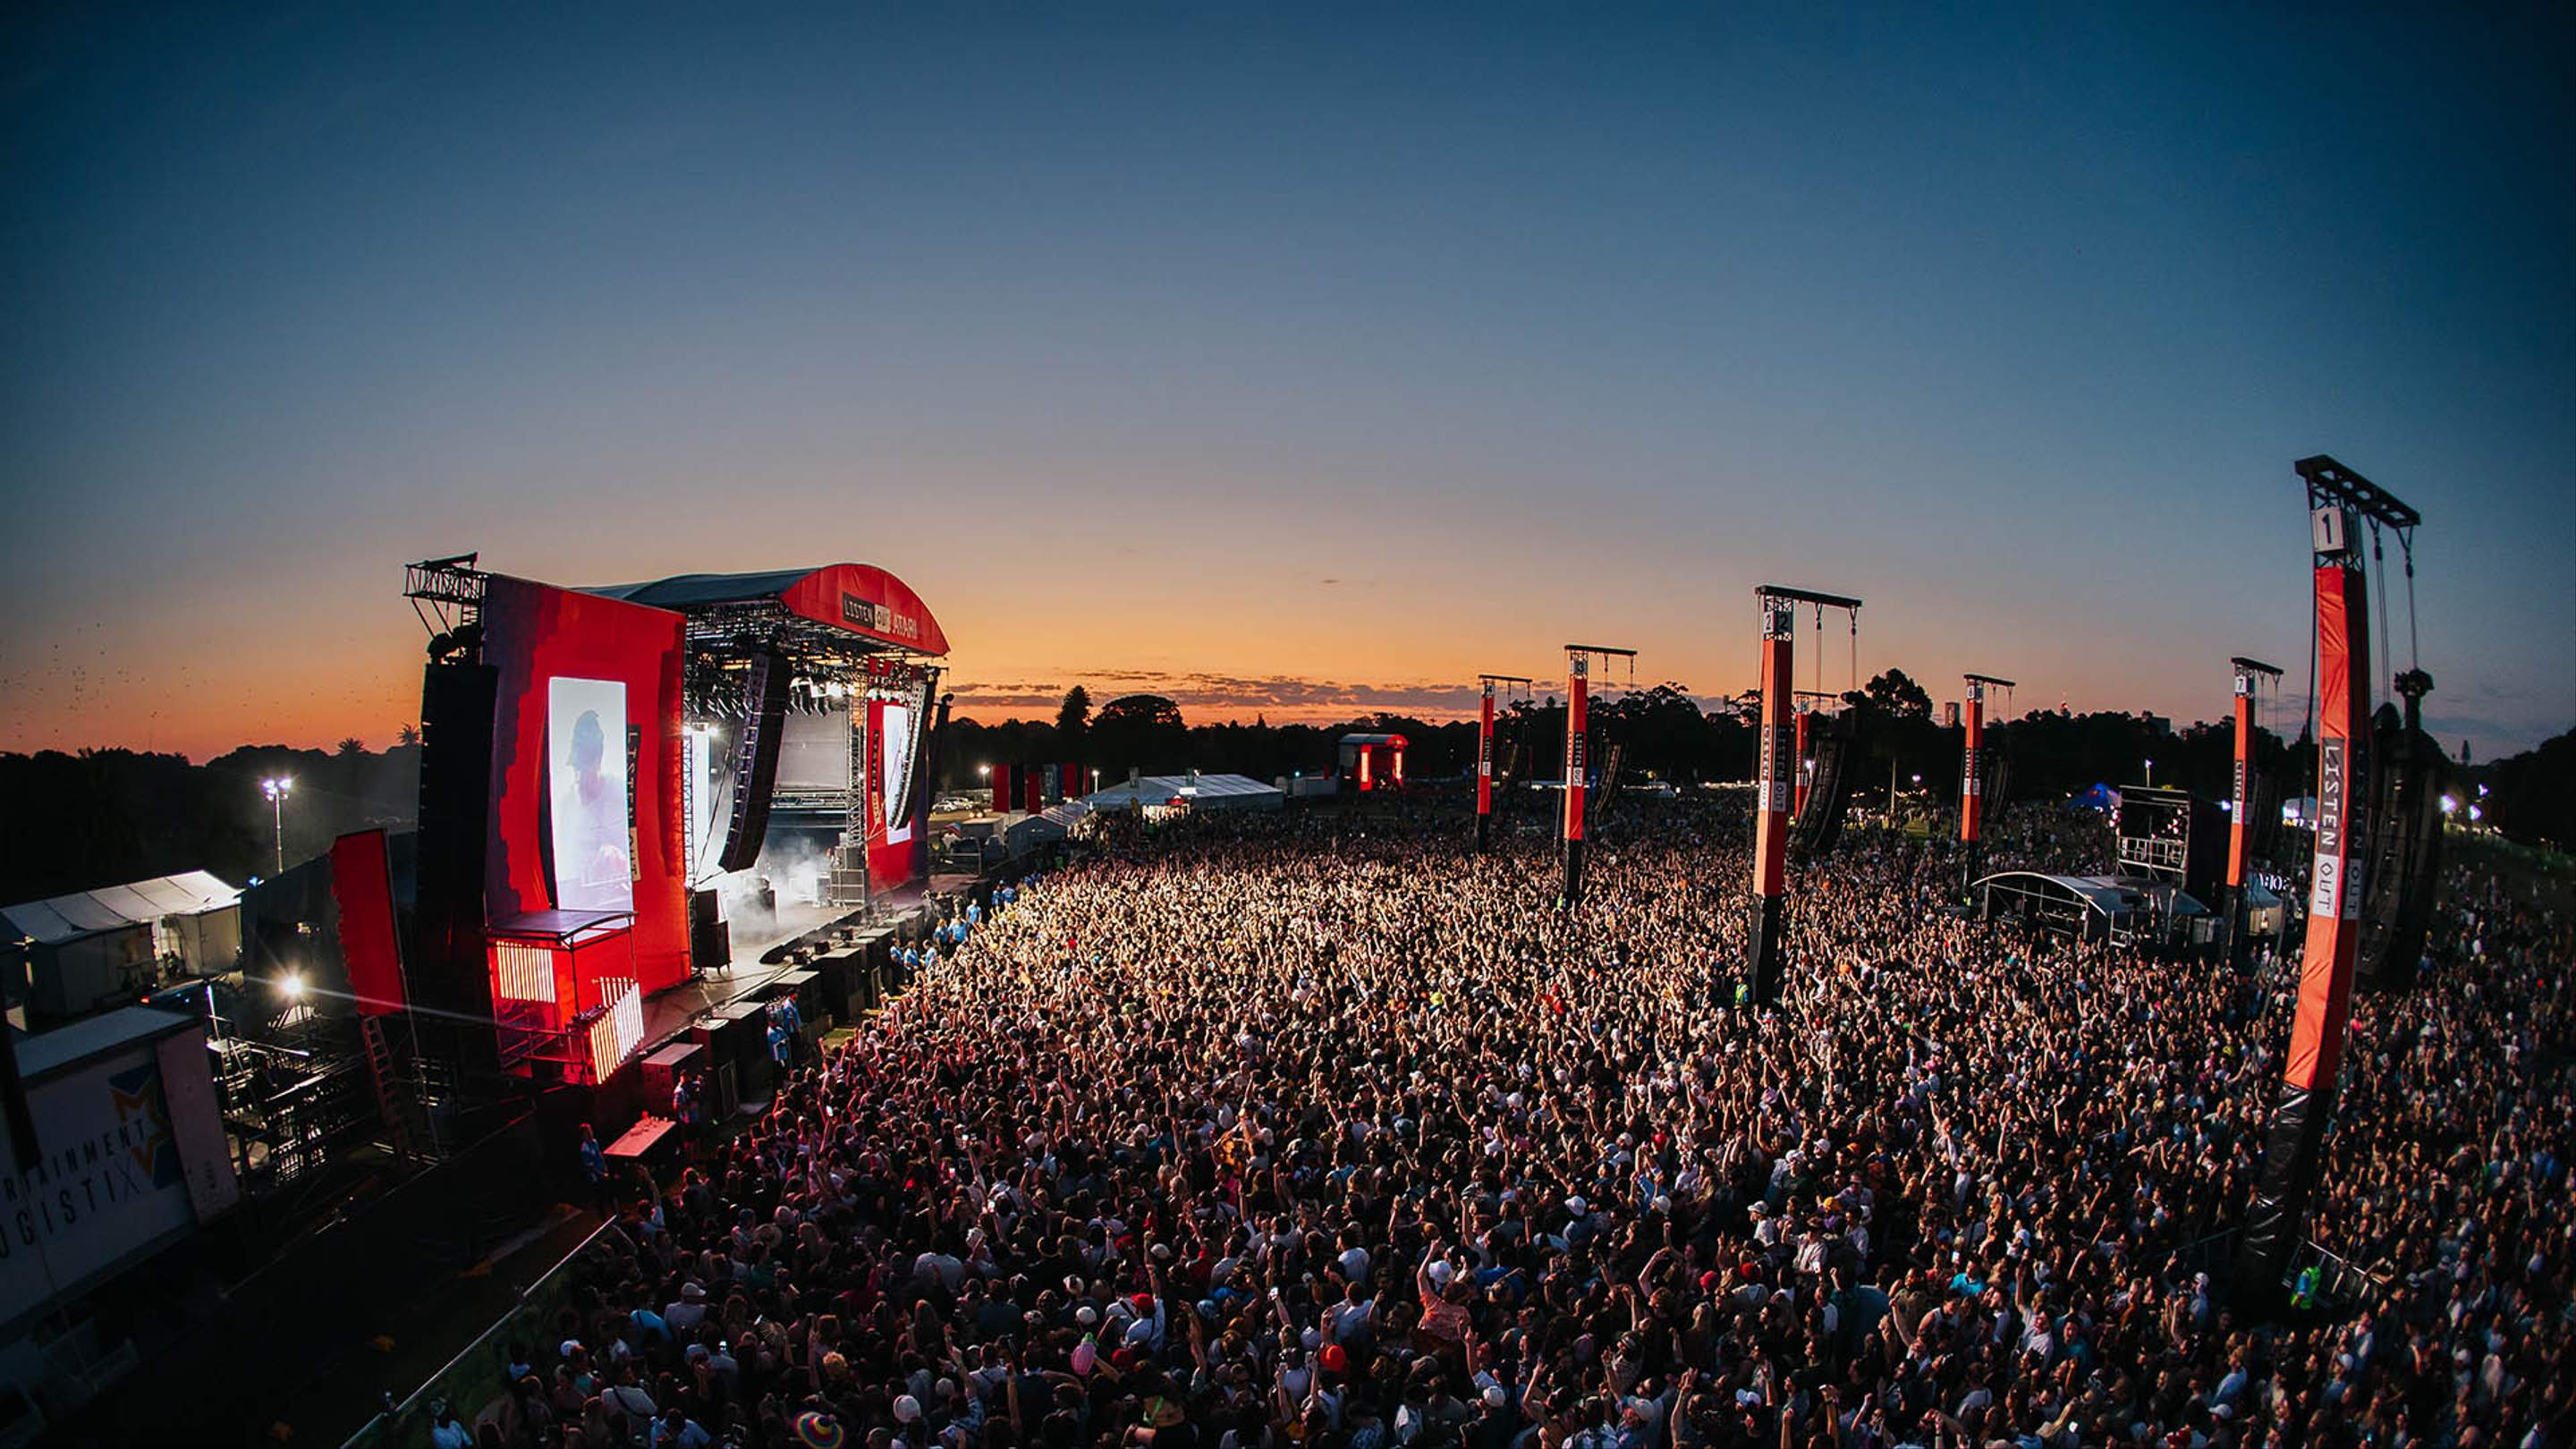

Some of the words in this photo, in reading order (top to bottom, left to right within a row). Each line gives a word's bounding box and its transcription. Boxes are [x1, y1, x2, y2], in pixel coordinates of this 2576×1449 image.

[2321, 513, 2332, 545] 1
[844, 600, 874, 623] LISTEN
[893, 614, 918, 640] ATARI
[1766, 614, 1771, 630] 2
[1780, 614, 1788, 630] 2
[2238, 678, 2243, 691] 7
[1575, 733, 1583, 767] LISTEN
[1775, 728, 1787, 779] LISTEN
[1775, 785, 1784, 809] OUT
[2321, 745, 2341, 847] LISTEN
[2318, 861, 2334, 911] OUT
[2348, 865, 2360, 913] OUT
